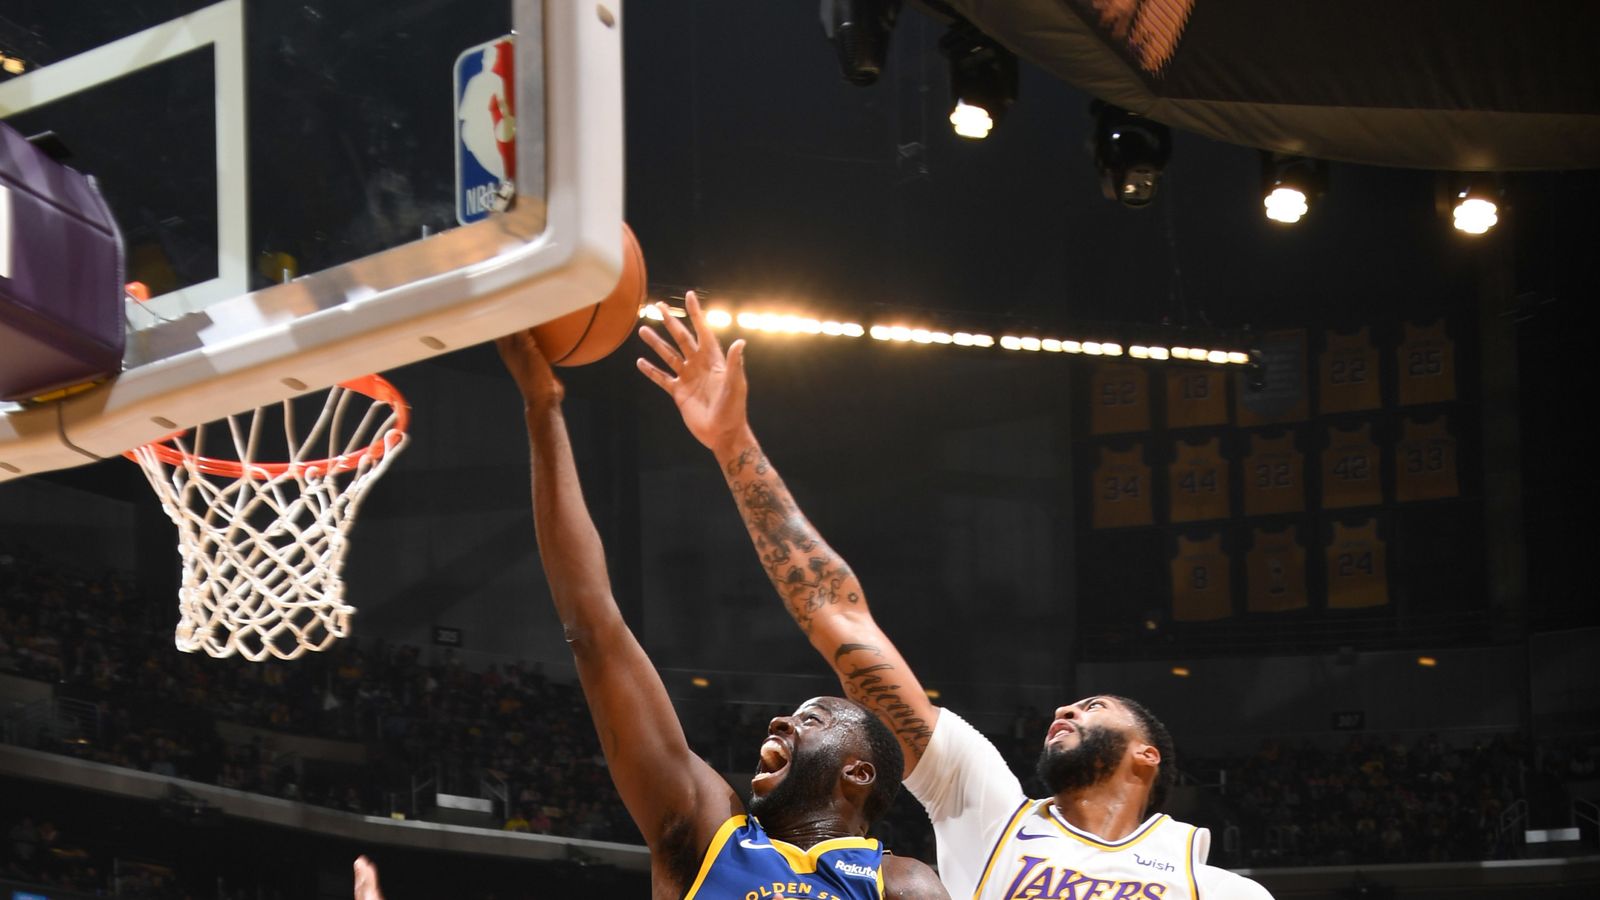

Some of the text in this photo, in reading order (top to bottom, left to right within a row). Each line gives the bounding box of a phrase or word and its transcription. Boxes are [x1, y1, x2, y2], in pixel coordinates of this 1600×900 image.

[466, 182, 498, 216] NBA
[1330, 358, 1367, 385] 22
[1409, 350, 1443, 376] 25
[1102, 383, 1137, 406] 52
[1334, 456, 1368, 480] 42
[1407, 446, 1443, 475] 33
[1178, 469, 1217, 495] 44
[1256, 463, 1292, 488] 32
[1104, 476, 1140, 502] 34
[1338, 551, 1373, 578] 24
[1191, 566, 1208, 590] 8
[835, 860, 877, 879] Rakute
[1002, 854, 1168, 900] LAKERS
[745, 882, 812, 900] OLDEN
